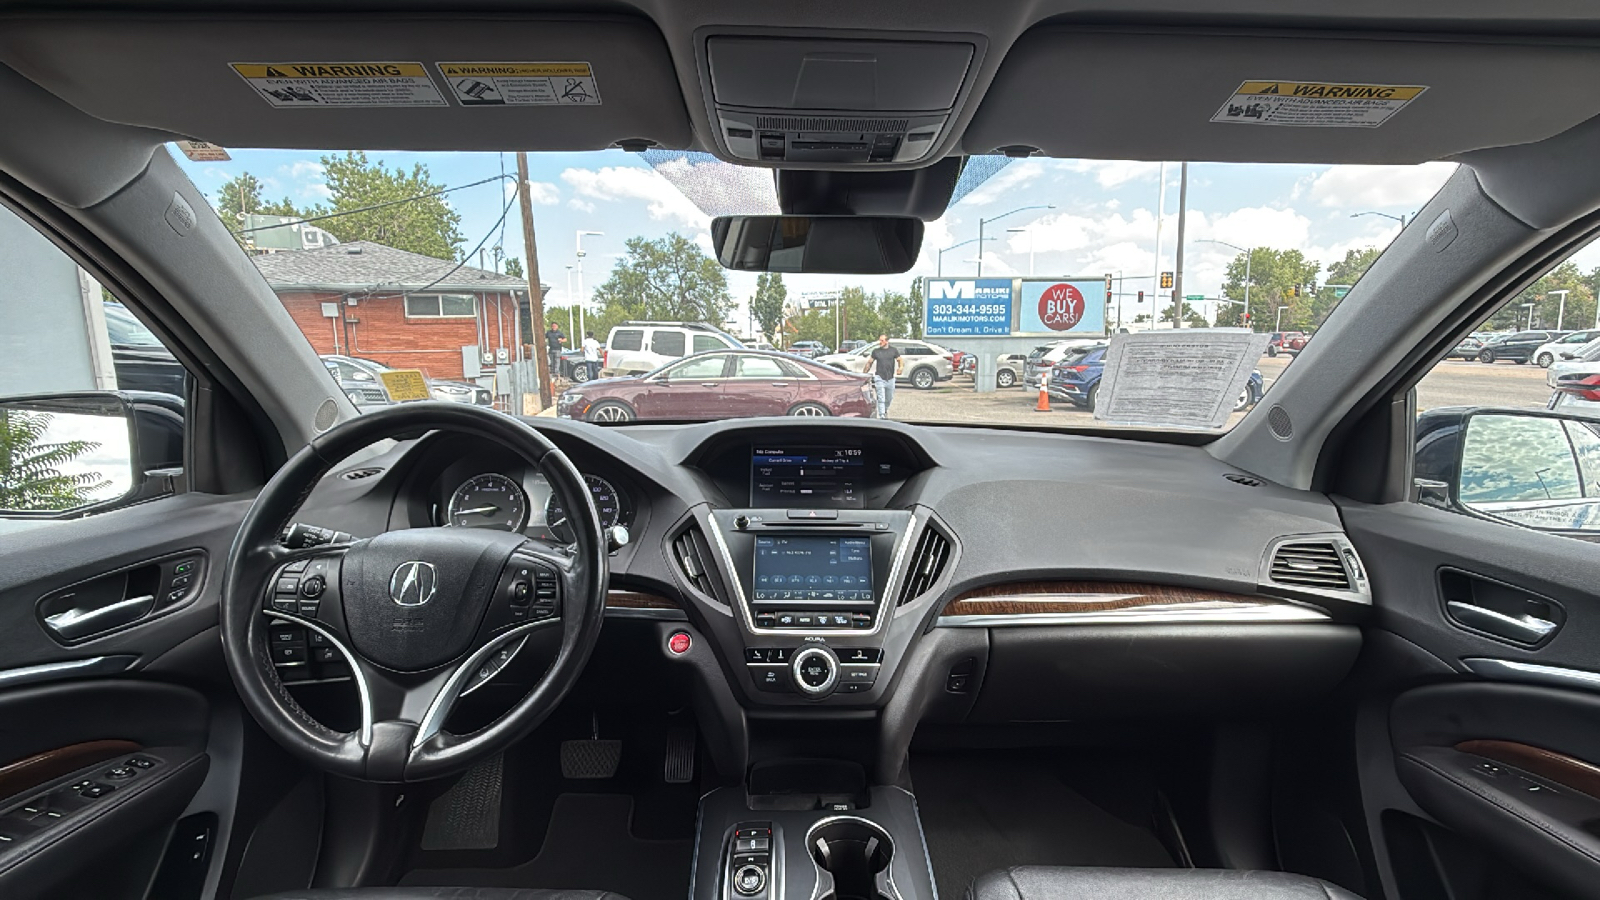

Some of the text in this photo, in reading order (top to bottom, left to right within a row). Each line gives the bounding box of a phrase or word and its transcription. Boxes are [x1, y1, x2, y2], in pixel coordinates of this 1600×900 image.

[292, 65, 401, 77] WARNING
[1292, 85, 1396, 98] WARNING
[1052, 288, 1073, 300] WE
[932, 304, 1006, 314] 303-344-9595
[1047, 300, 1077, 314] BUY
[1044, 313, 1078, 324] CARS!
